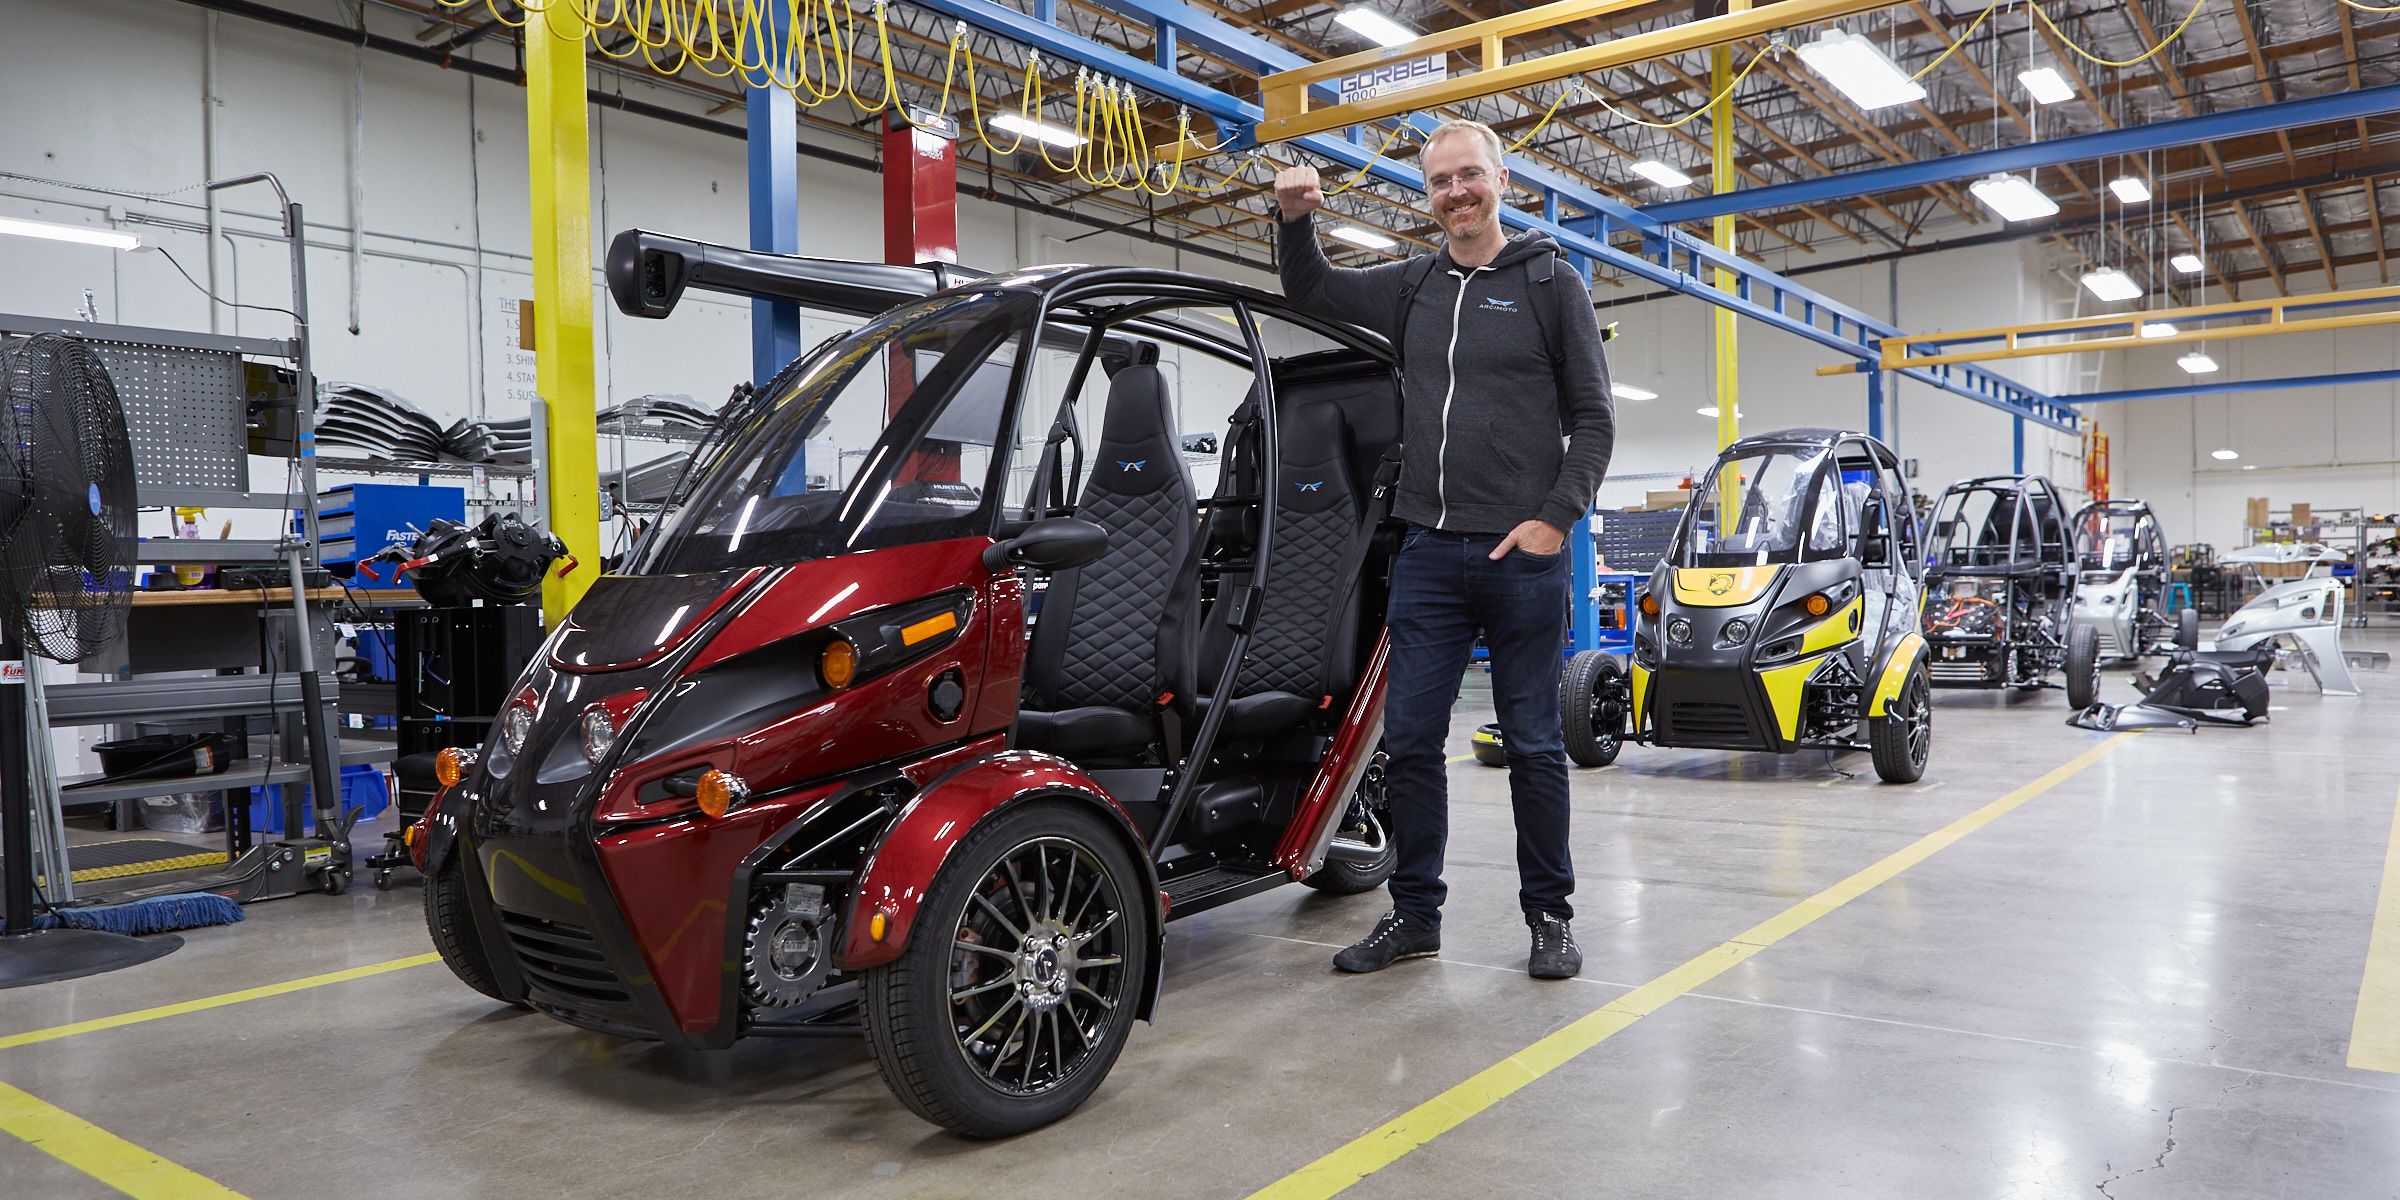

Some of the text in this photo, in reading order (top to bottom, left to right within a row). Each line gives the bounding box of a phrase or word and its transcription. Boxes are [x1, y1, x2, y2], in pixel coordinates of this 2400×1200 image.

[1341, 57, 1444, 94] GORBEL
[1345, 87, 1377, 103] 1000
[499, 298, 518, 311] THE
[1479, 304, 1518, 313] ARCIMOTO
[506, 319, 514, 330] 1.
[506, 337, 514, 347] 2.
[507, 354, 515, 365] 3.
[507, 372, 515, 383] 4.
[508, 389, 516, 400] 5.
[386, 529, 419, 541] FASTE
